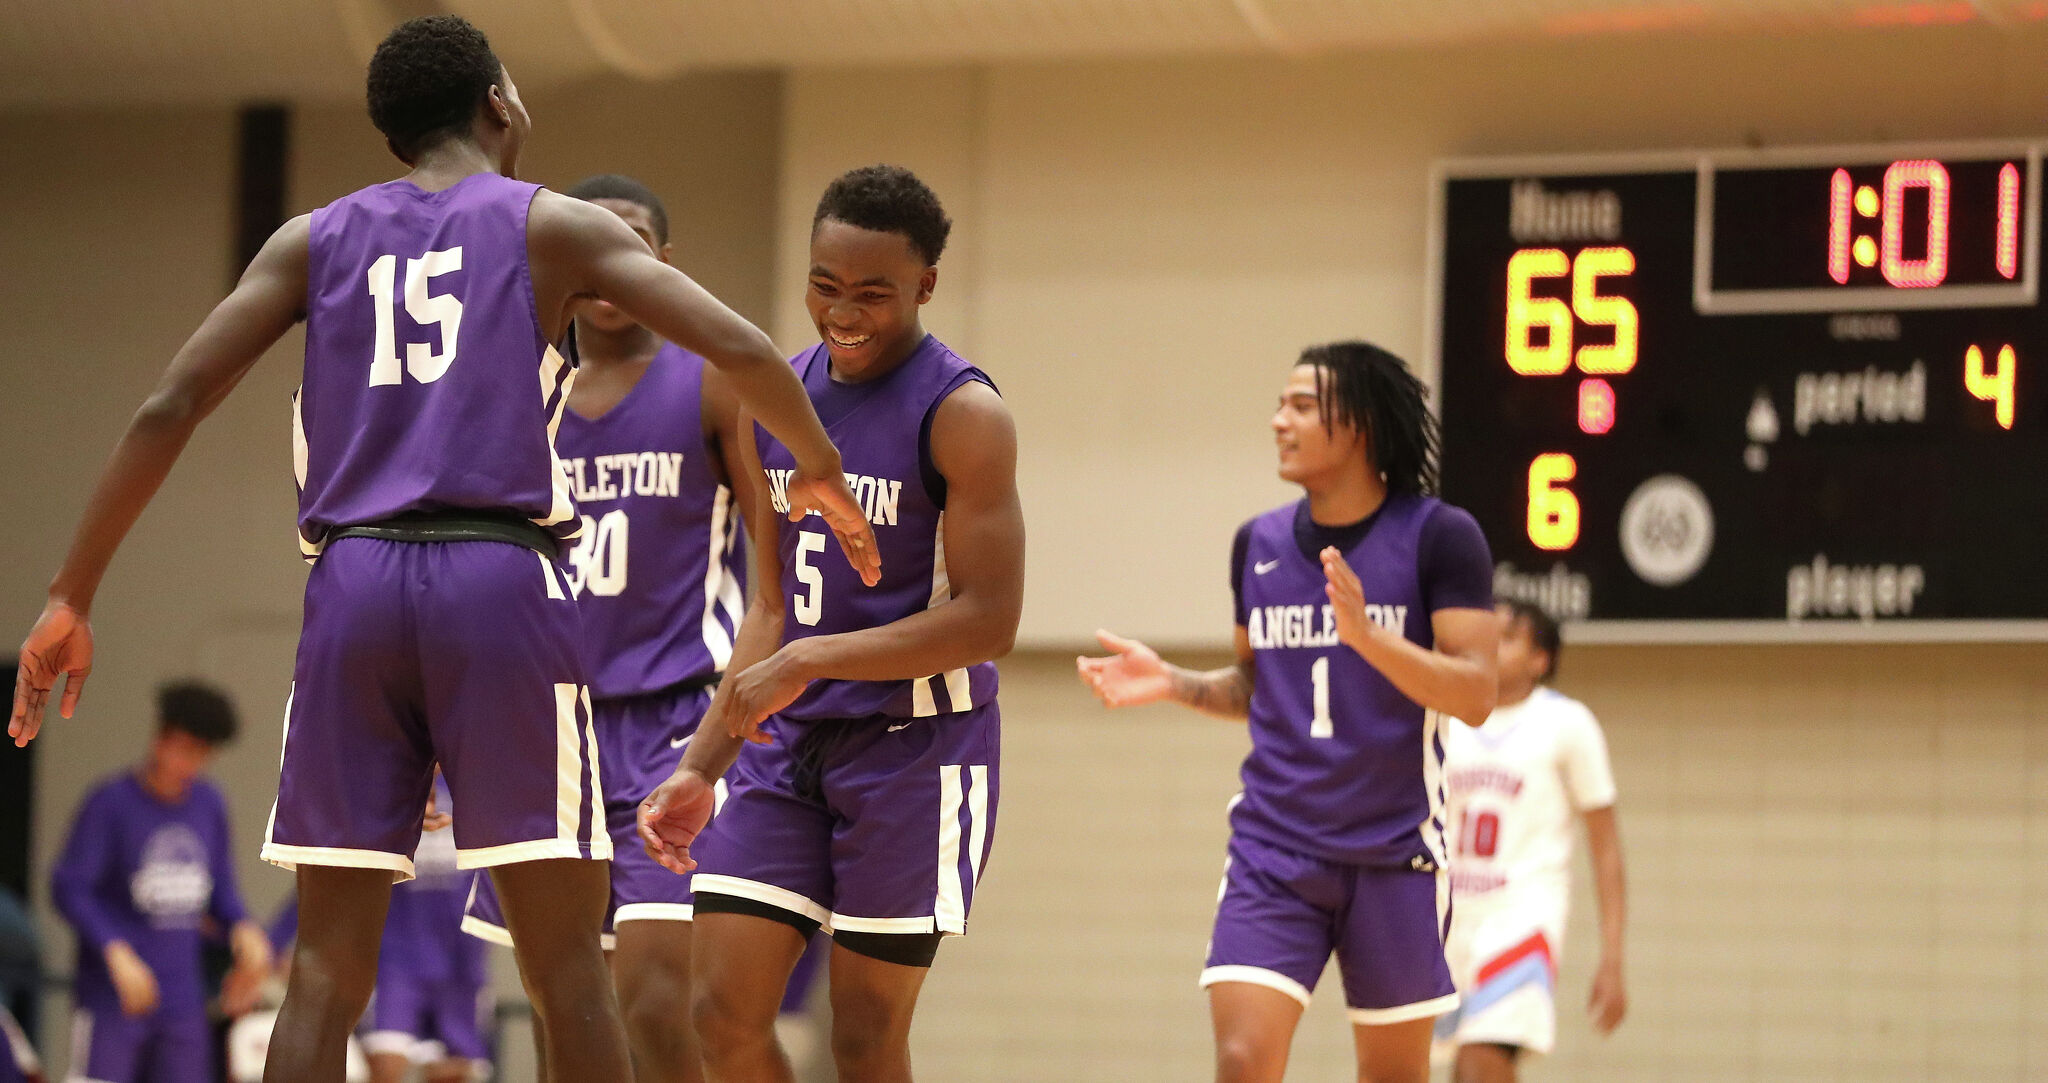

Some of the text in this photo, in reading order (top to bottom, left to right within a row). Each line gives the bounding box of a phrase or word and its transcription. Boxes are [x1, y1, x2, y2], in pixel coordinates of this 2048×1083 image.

[1828, 160, 2018, 288] 1:01
[367, 246, 463, 387] 15
[1505, 247, 1639, 376] 65
[1794, 359, 1926, 436] period
[1964, 344, 2016, 430] 4
[560, 451, 684, 503] GLETON
[1527, 452, 1580, 550] 6
[569, 509, 630, 597] 30
[794, 530, 827, 627] 5
[1786, 552, 1926, 624] player
[1247, 603, 1409, 650] ANGLEON
[1310, 656, 1334, 739] 1
